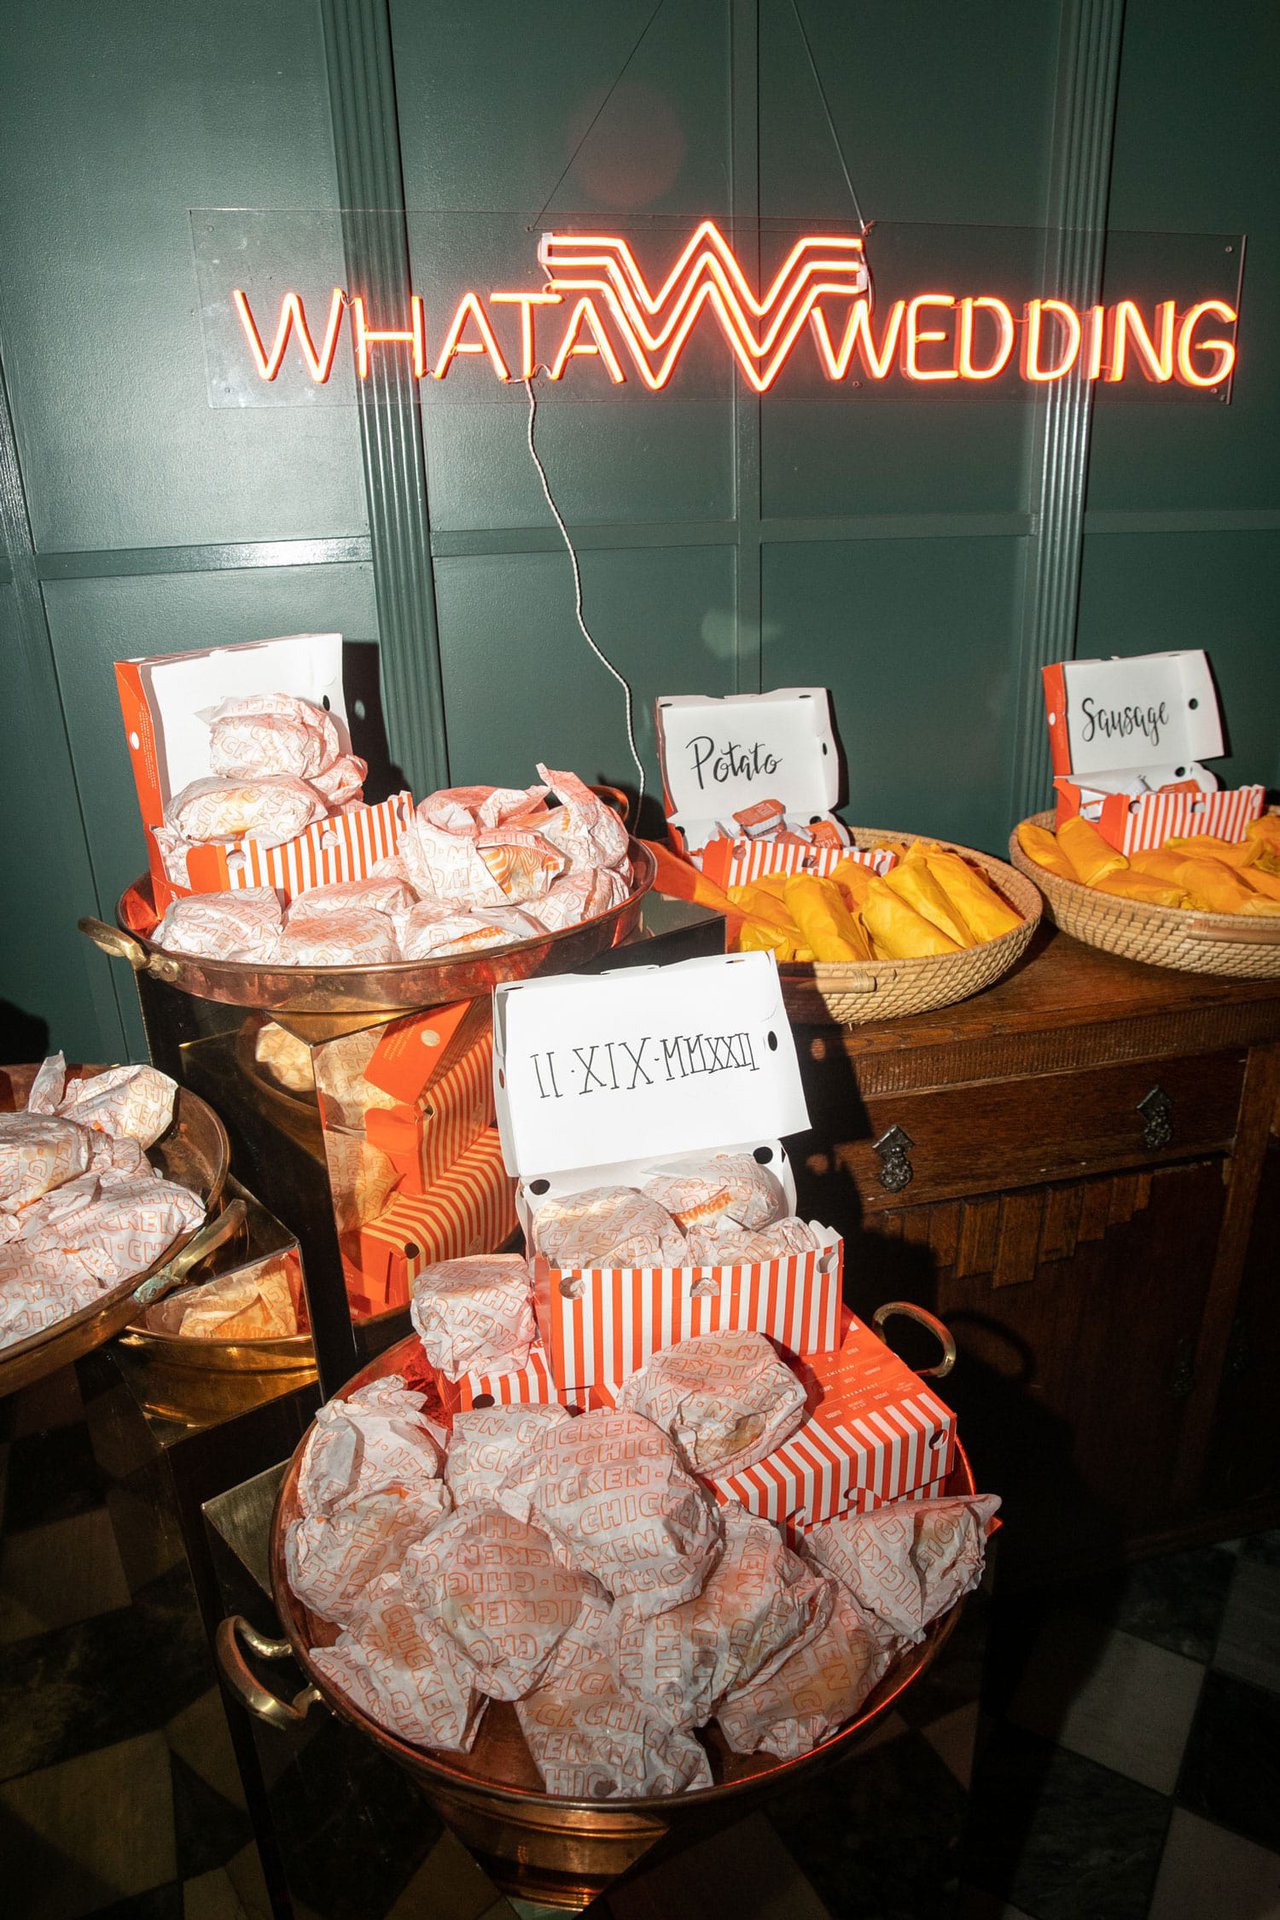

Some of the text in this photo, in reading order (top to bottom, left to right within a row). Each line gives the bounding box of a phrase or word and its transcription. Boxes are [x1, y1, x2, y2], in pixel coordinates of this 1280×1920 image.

[1081, 697, 1170, 747] Sausage
[685, 735, 784, 790] Potato
[380, 1604, 460, 1743] CHICKEN
